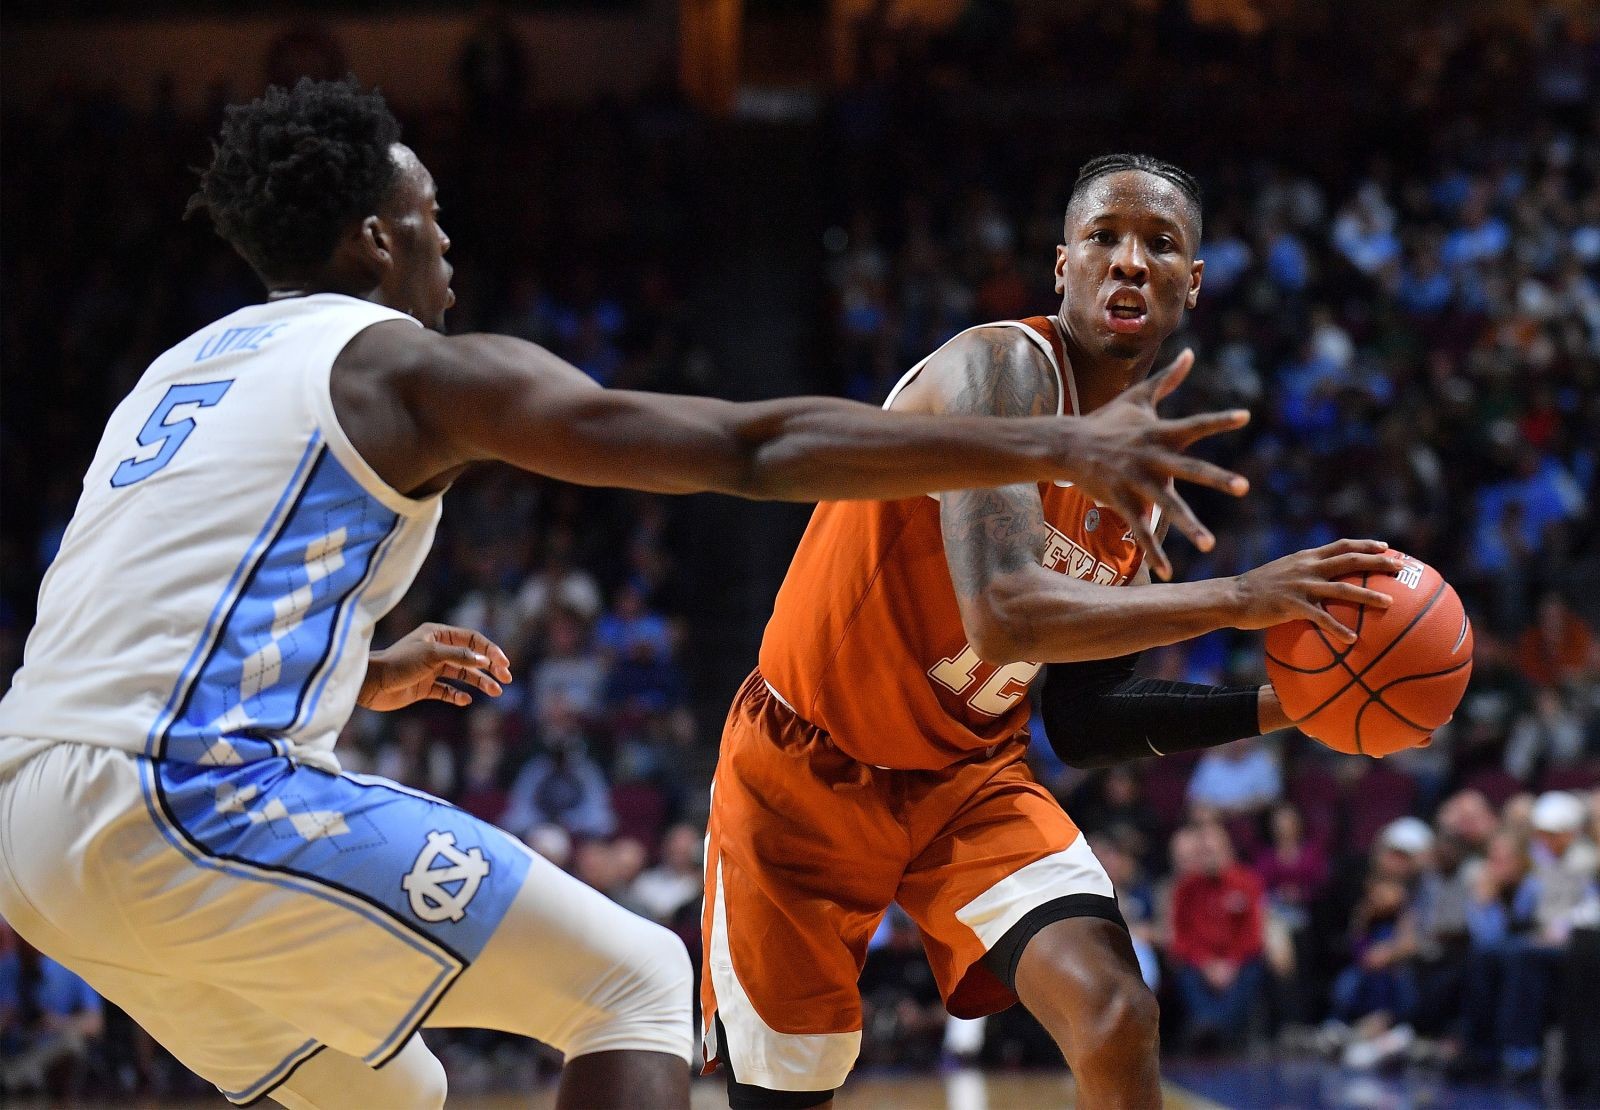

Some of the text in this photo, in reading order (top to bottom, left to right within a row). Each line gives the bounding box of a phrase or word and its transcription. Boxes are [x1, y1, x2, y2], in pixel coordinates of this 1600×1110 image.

[194, 322, 288, 362] LITTLE
[110, 378, 236, 488] 5
[927, 642, 1042, 718] 12
